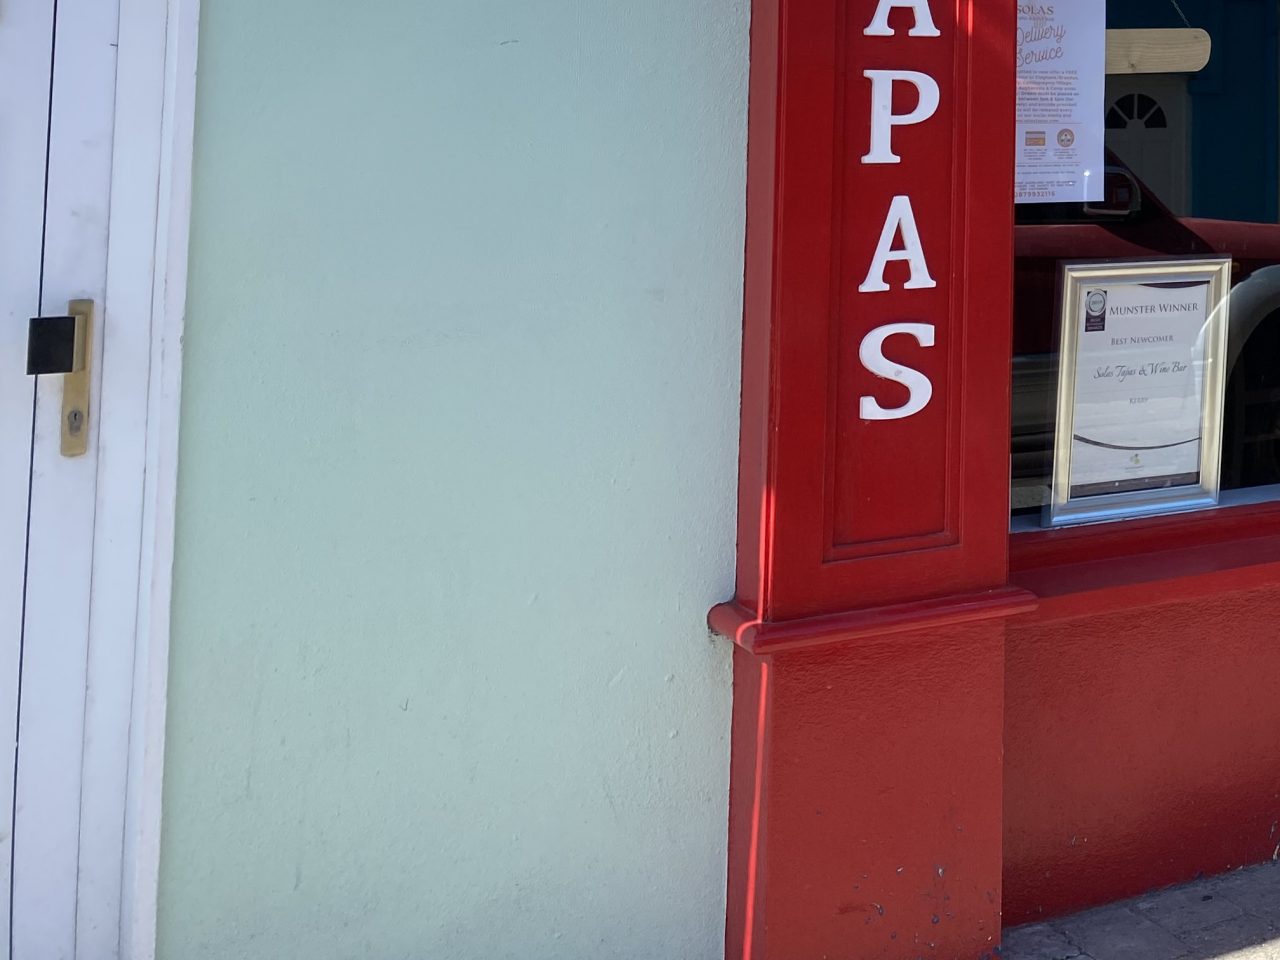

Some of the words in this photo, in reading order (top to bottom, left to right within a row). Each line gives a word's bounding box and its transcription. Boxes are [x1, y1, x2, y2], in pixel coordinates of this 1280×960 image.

[1017, 4, 1054, 16] SOLAS
[1016, 46, 1065, 68] Service
[1109, 305, 1156, 316] MUNSTER
[1158, 302, 1199, 313] WINNER
[1111, 337, 1129, 346] BEST
[1129, 335, 1174, 345] NEWCOMER
[1138, 366, 1148, 377] &
[1171, 360, 1188, 373] Bar
